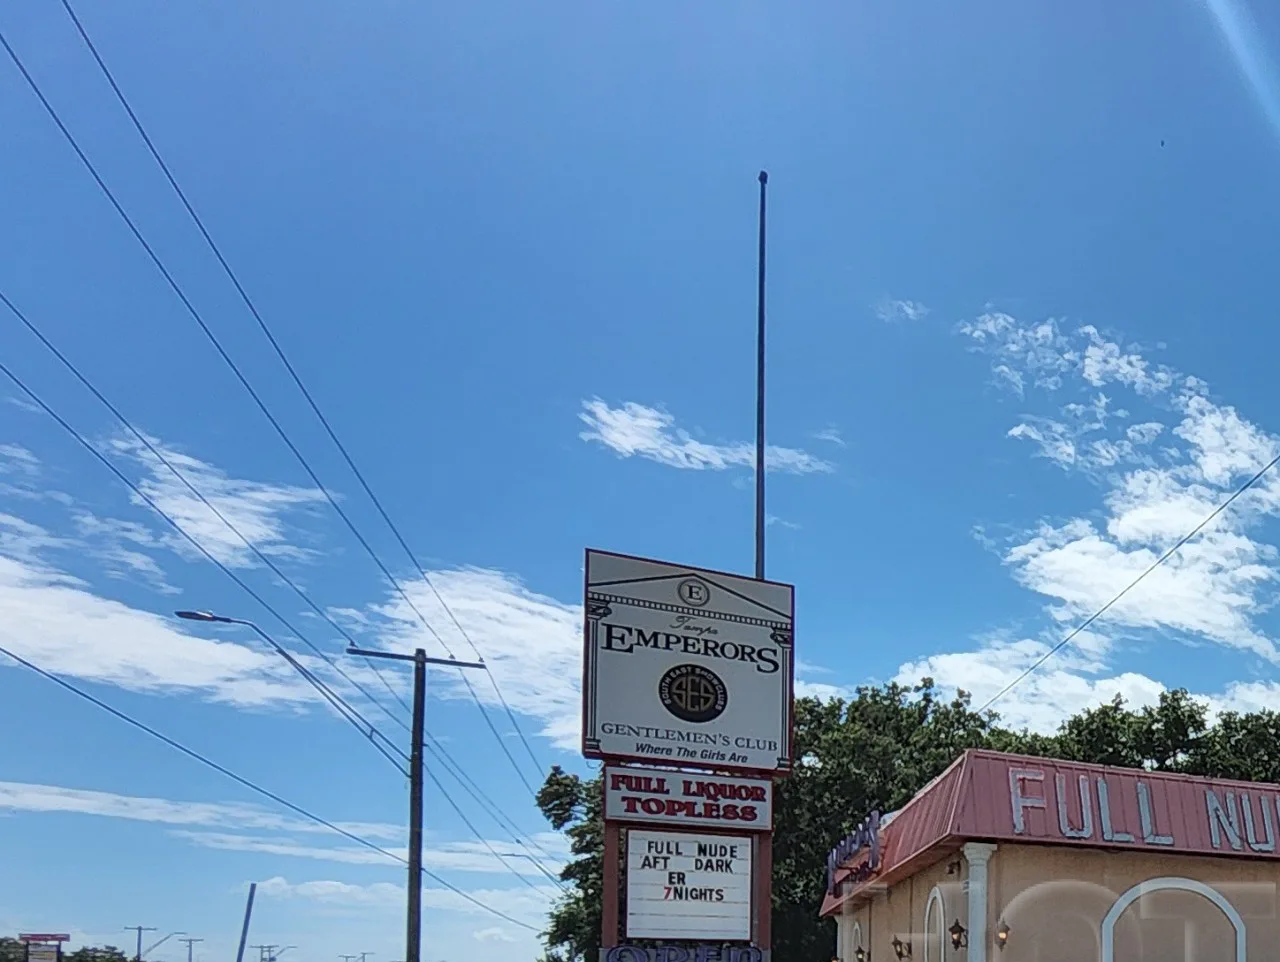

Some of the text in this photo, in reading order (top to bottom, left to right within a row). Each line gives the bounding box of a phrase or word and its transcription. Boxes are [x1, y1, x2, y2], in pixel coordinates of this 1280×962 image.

[686, 585, 702, 600] E
[670, 616, 718, 636] Tampa
[601, 622, 779, 673] EMPERORS
[661, 676, 672, 704] SOUTH
[670, 666, 691, 678] EAST
[601, 722, 778, 751] GENTLEMEN'S CLUB
[635, 742, 749, 764] Where The Girls Are
[610, 774, 767, 802] FULL LIQUOR
[621, 796, 758, 822] TOPLESS
[1007, 767, 1174, 845] FULL
[647, 841, 738, 858] FULL NUDE
[641, 856, 733, 873] AFT DARK
[668, 872, 686, 885] ER
